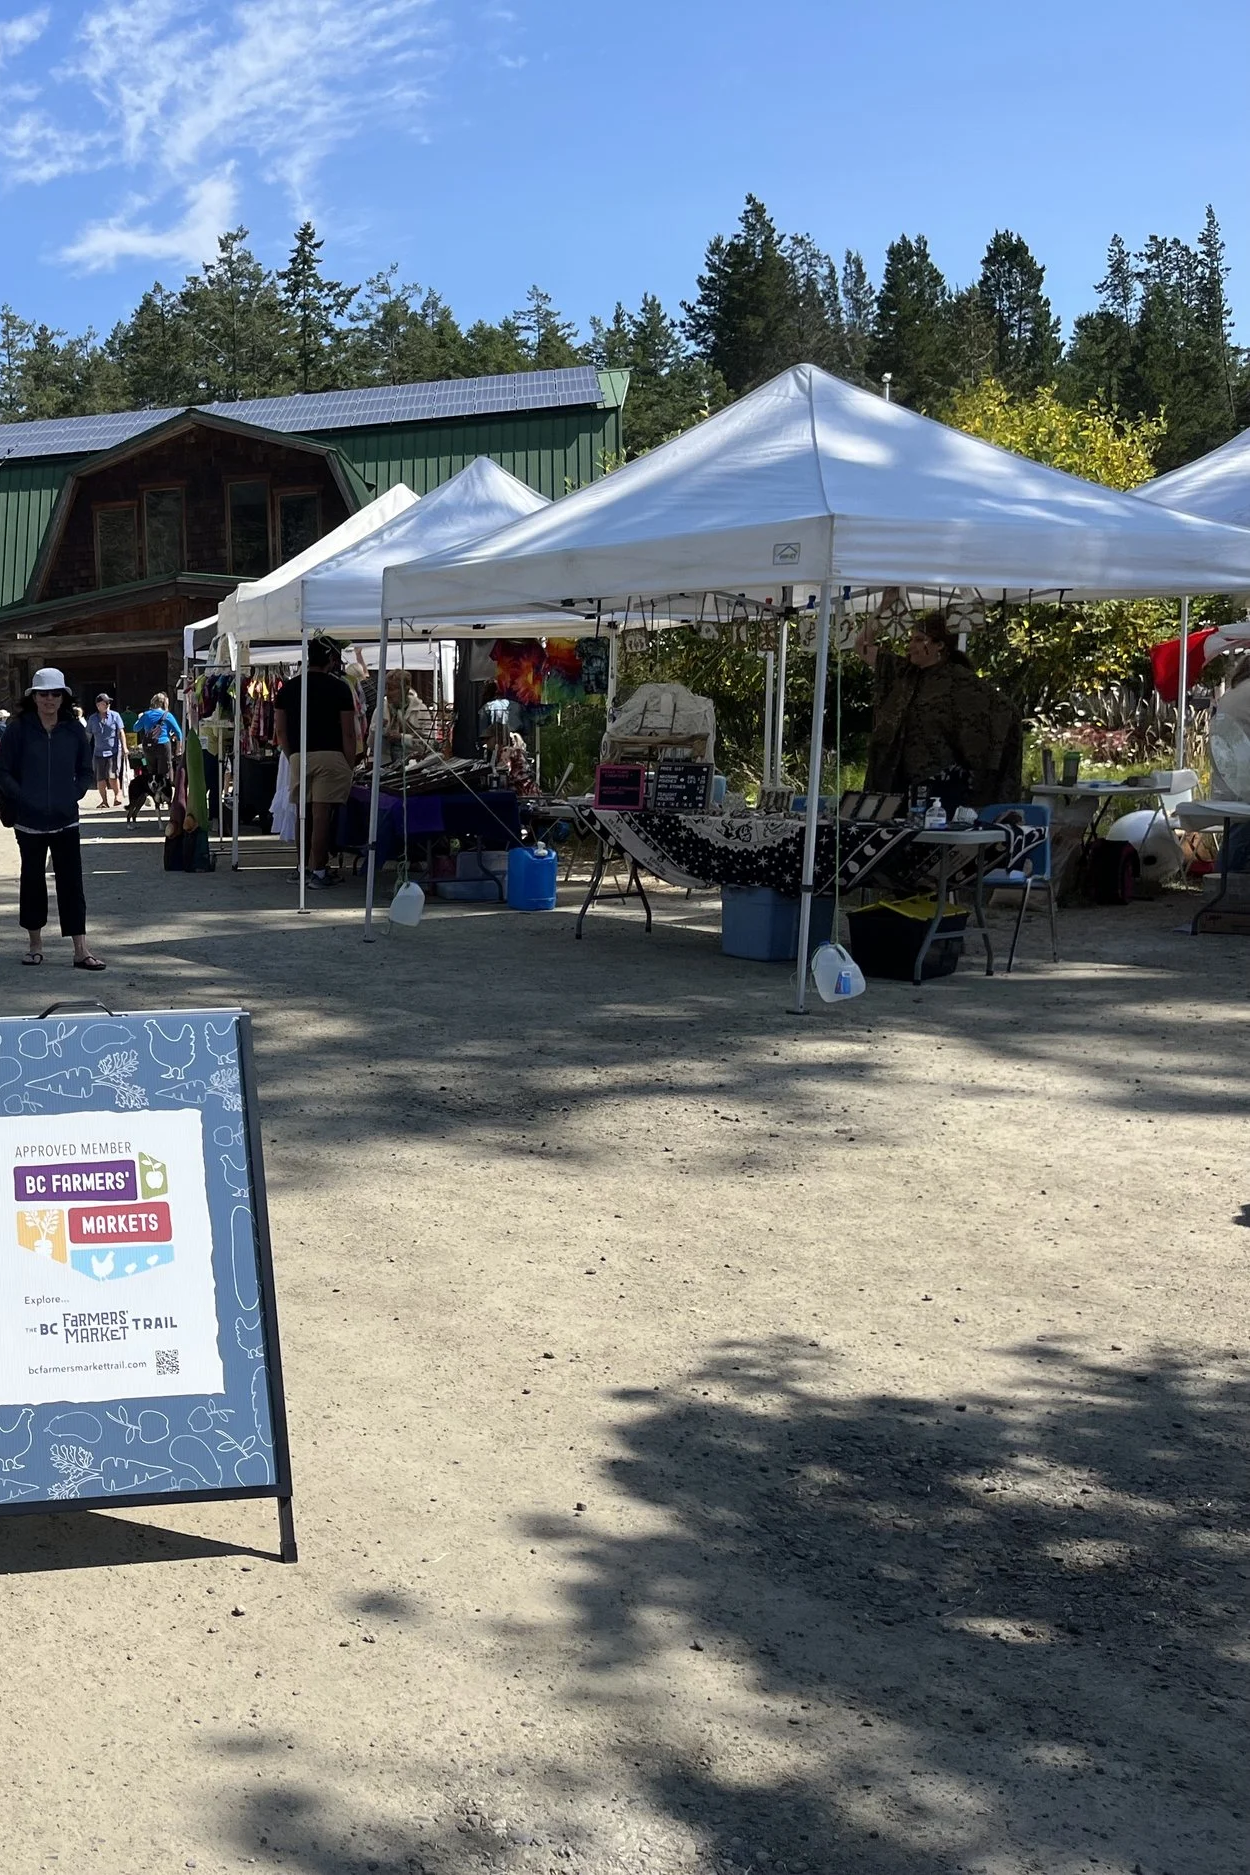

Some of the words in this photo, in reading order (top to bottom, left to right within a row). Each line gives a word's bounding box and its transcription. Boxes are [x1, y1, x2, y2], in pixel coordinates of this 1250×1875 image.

[15, 1144, 77, 1158] APPROVED
[81, 1141, 132, 1155] MEMBER
[25, 1175, 47, 1194] BC
[51, 1171, 130, 1193] FARMERS'
[81, 1213, 159, 1235] MARKETS
[39, 1322, 59, 1336] BC
[132, 1316, 178, 1330] TRAIL
[28, 1360, 147, 1375] bcfarmersmarkettrail.com
